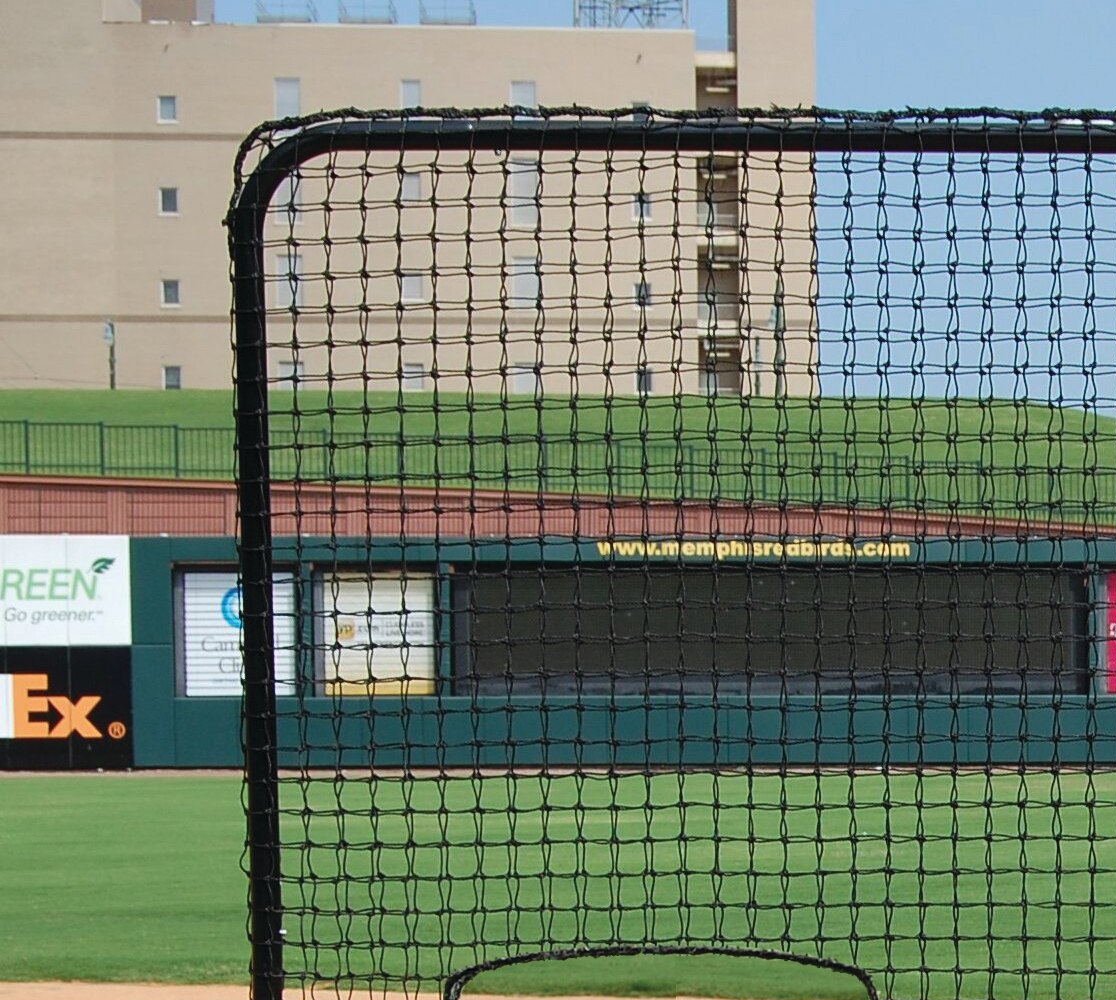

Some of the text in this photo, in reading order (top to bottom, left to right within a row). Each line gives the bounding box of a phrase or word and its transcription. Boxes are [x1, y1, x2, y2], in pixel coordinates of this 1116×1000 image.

[4, 607, 95, 625] Go greener.
[0, 673, 103, 738] Ex
